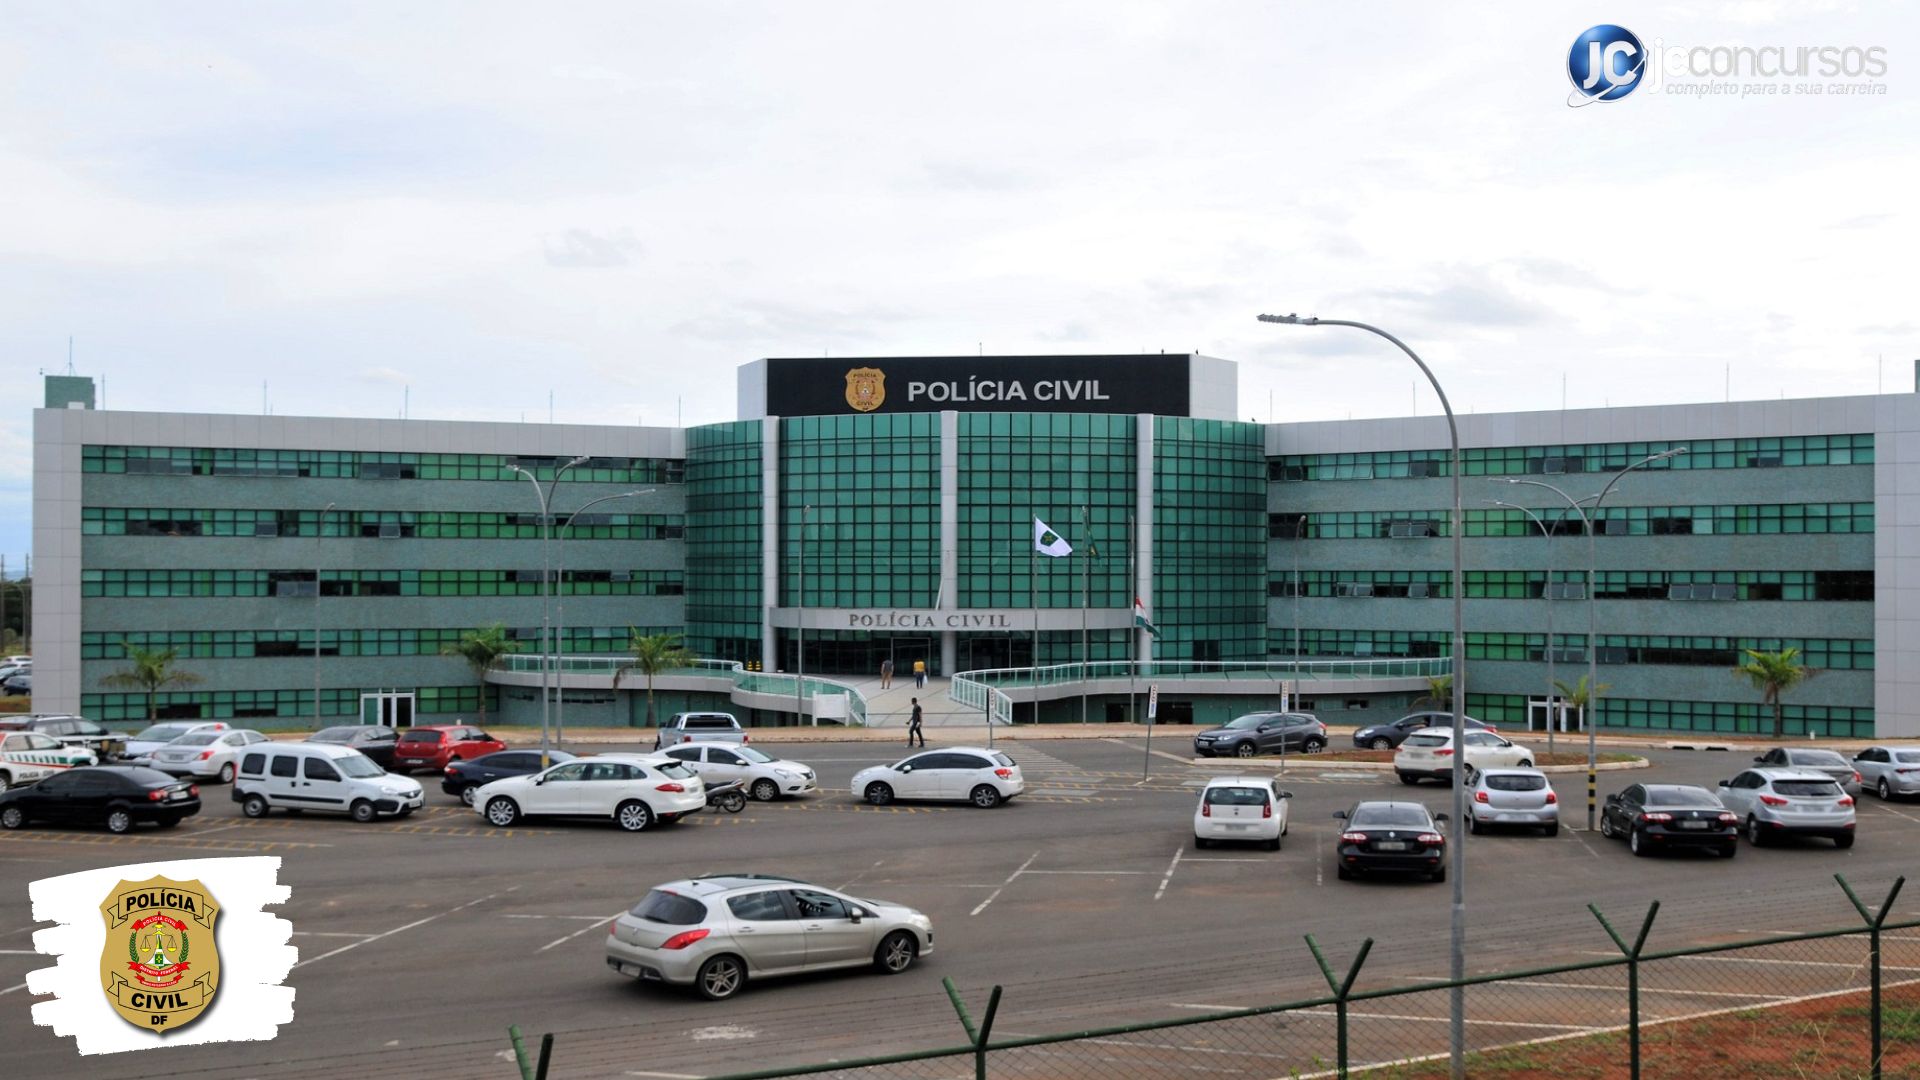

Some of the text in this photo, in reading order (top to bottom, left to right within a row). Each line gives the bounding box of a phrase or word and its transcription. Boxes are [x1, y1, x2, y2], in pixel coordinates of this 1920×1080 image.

[908, 375, 1110, 401] POLÍCIA CIVIL
[849, 611, 1011, 628] POLÍCIA CIVIL
